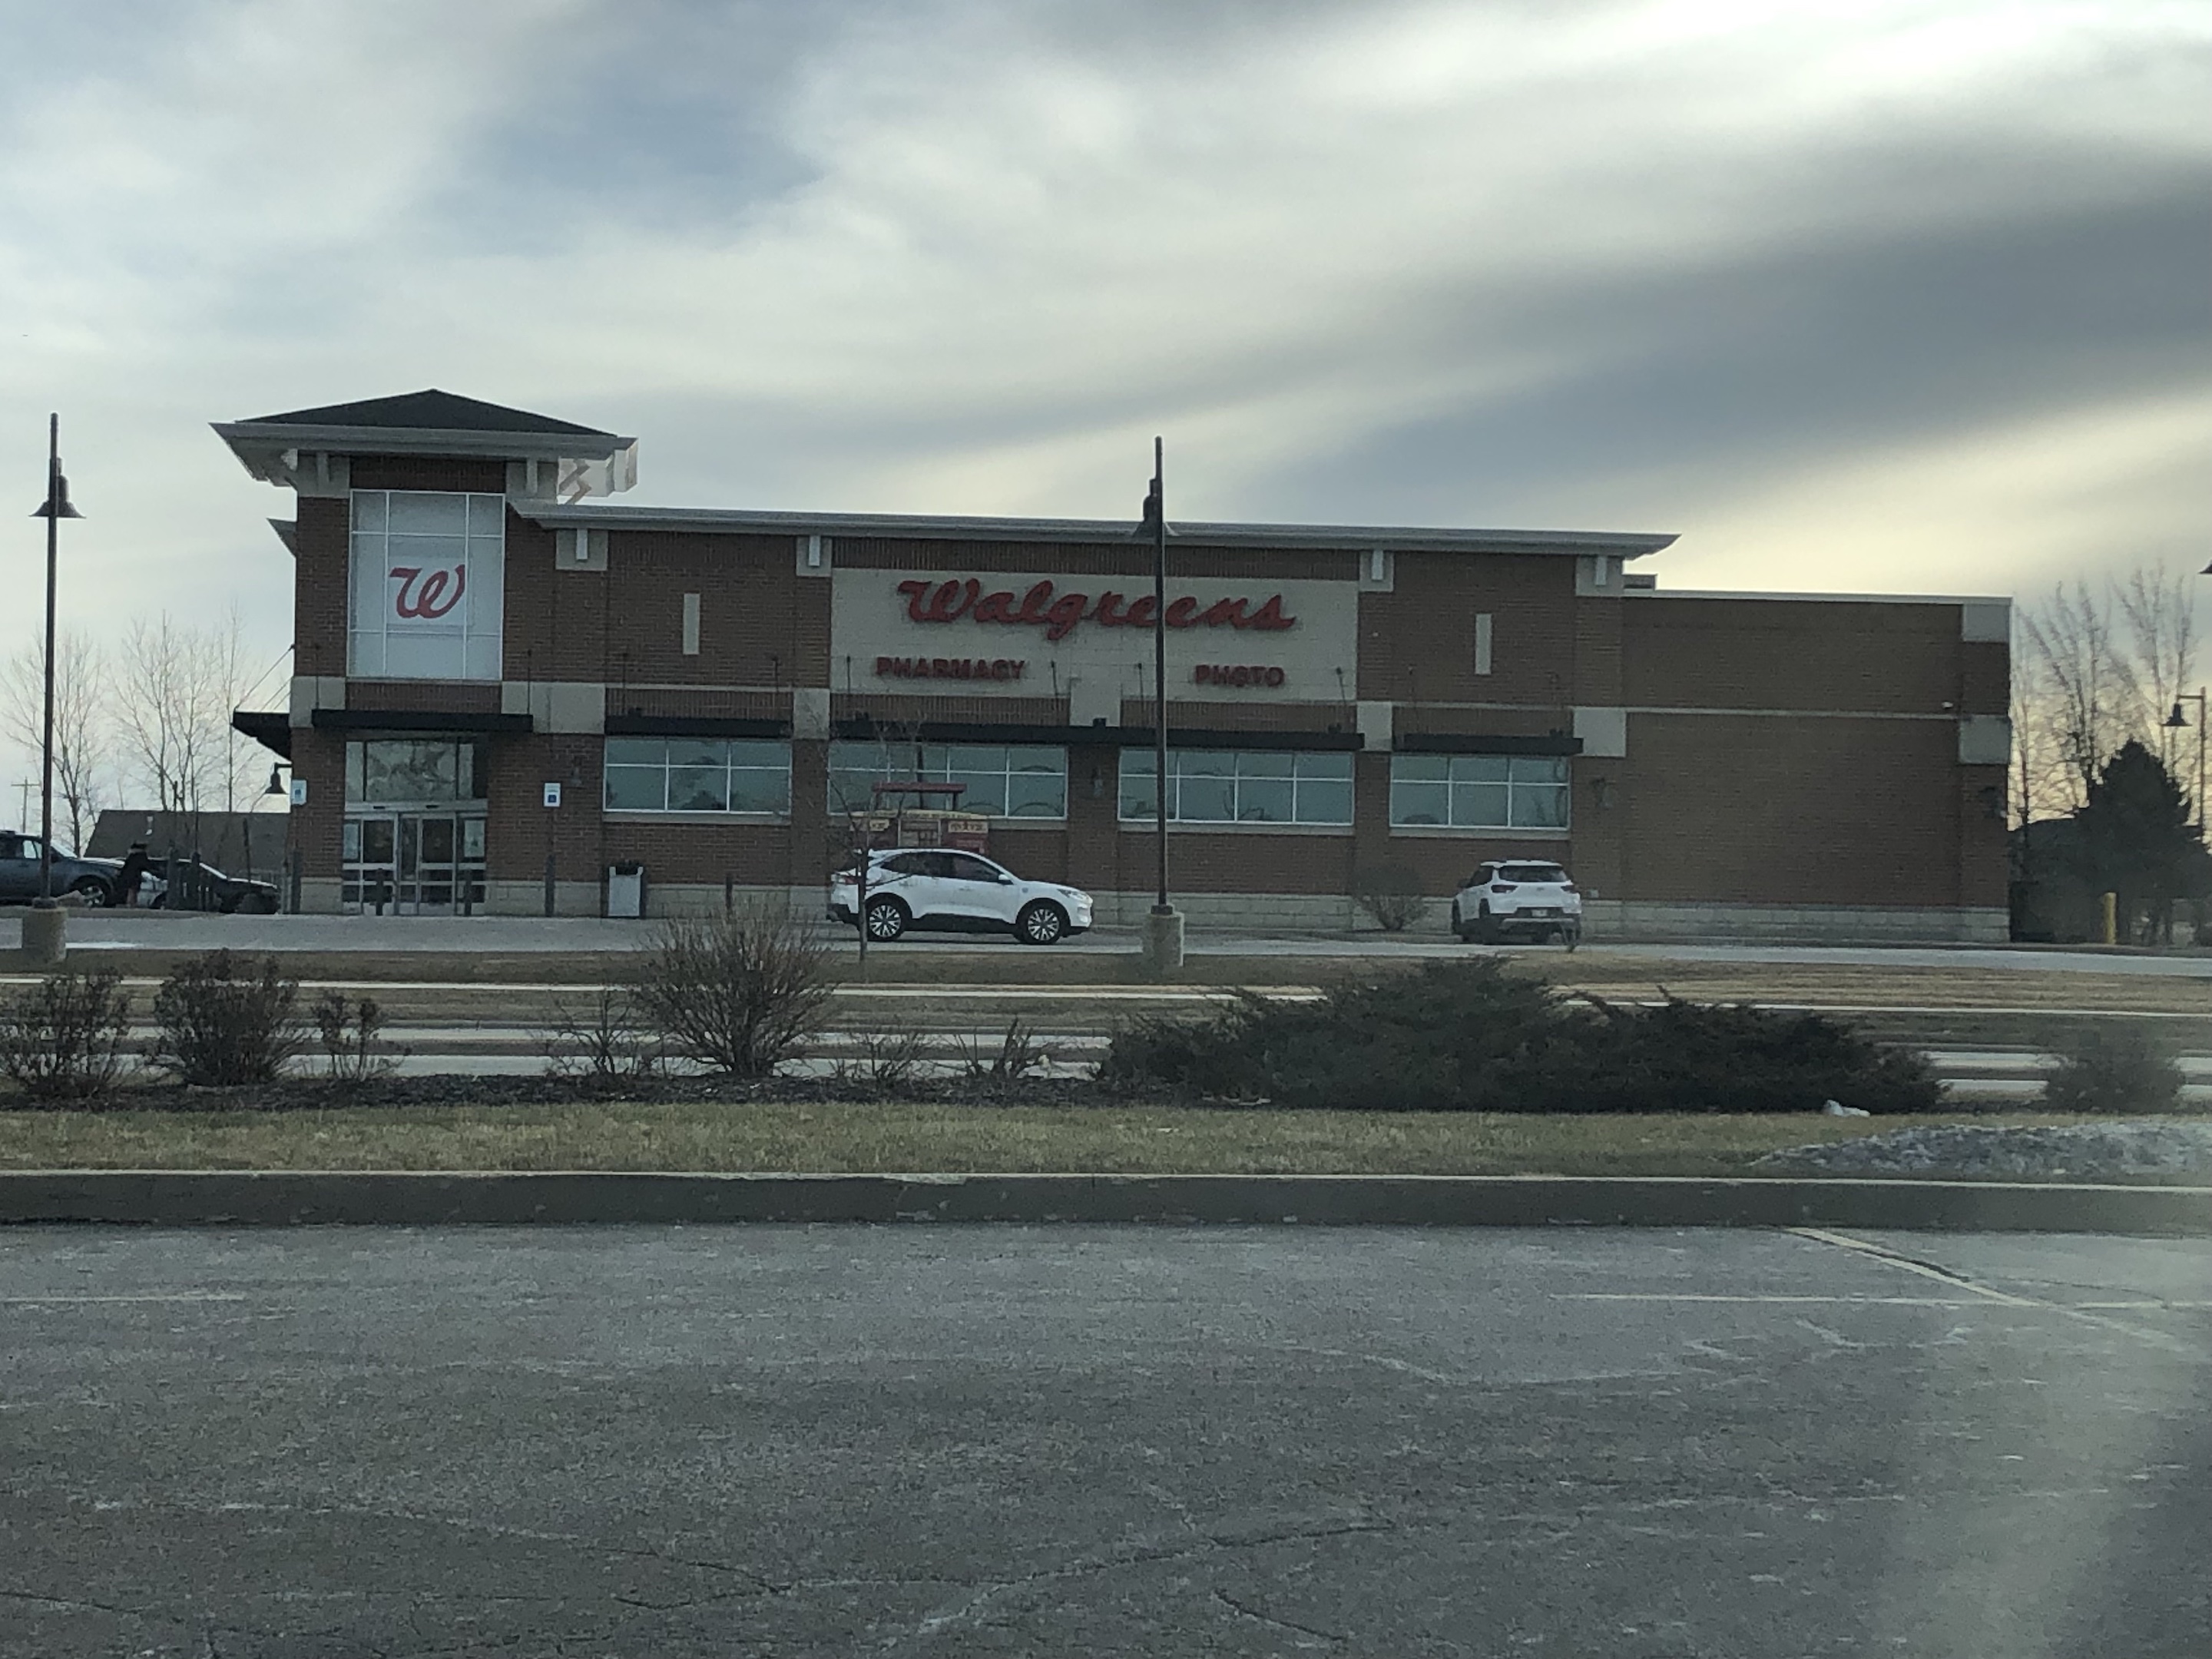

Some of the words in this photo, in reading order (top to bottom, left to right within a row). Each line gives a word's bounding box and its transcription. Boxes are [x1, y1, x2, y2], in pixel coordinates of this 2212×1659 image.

[389, 564, 465, 619] W
[897, 578, 1296, 641] Walgreens
[876, 656, 1026, 681] PHARMACY
[1195, 664, 1285, 687] PHOTO
